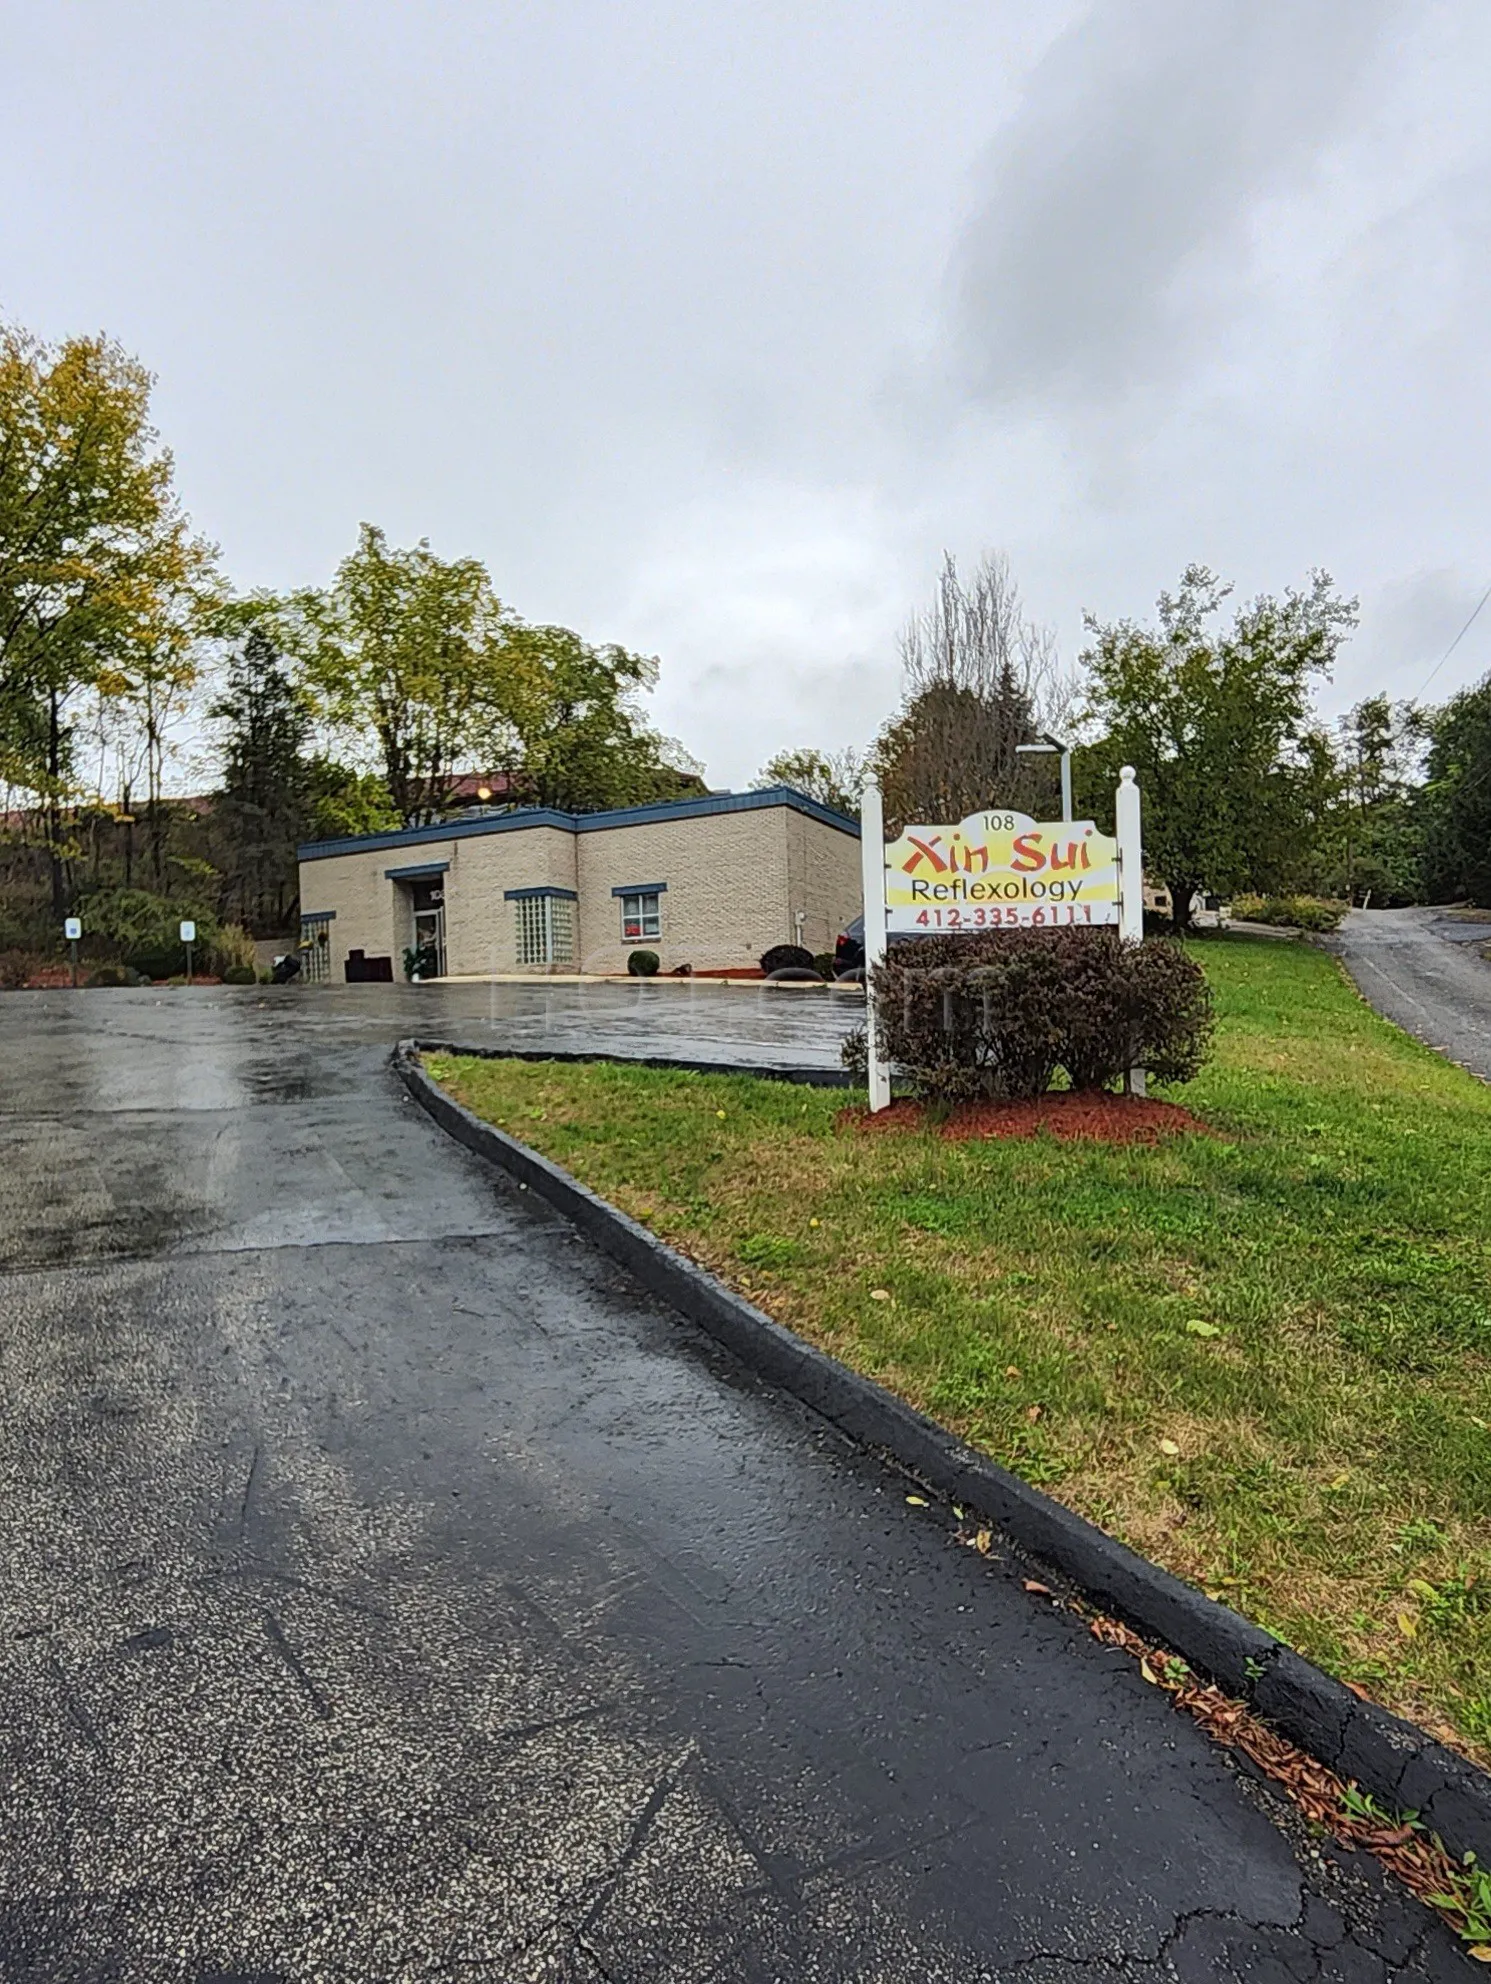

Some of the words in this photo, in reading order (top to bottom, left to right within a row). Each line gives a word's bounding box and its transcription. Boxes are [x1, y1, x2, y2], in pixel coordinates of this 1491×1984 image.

[983, 815, 1015, 831] 108
[901, 833, 989, 874] Xin
[1010, 829, 1092, 871] Sui
[911, 877, 1083, 901] Reflexology
[915, 904, 1092, 927] 412-335-6111
